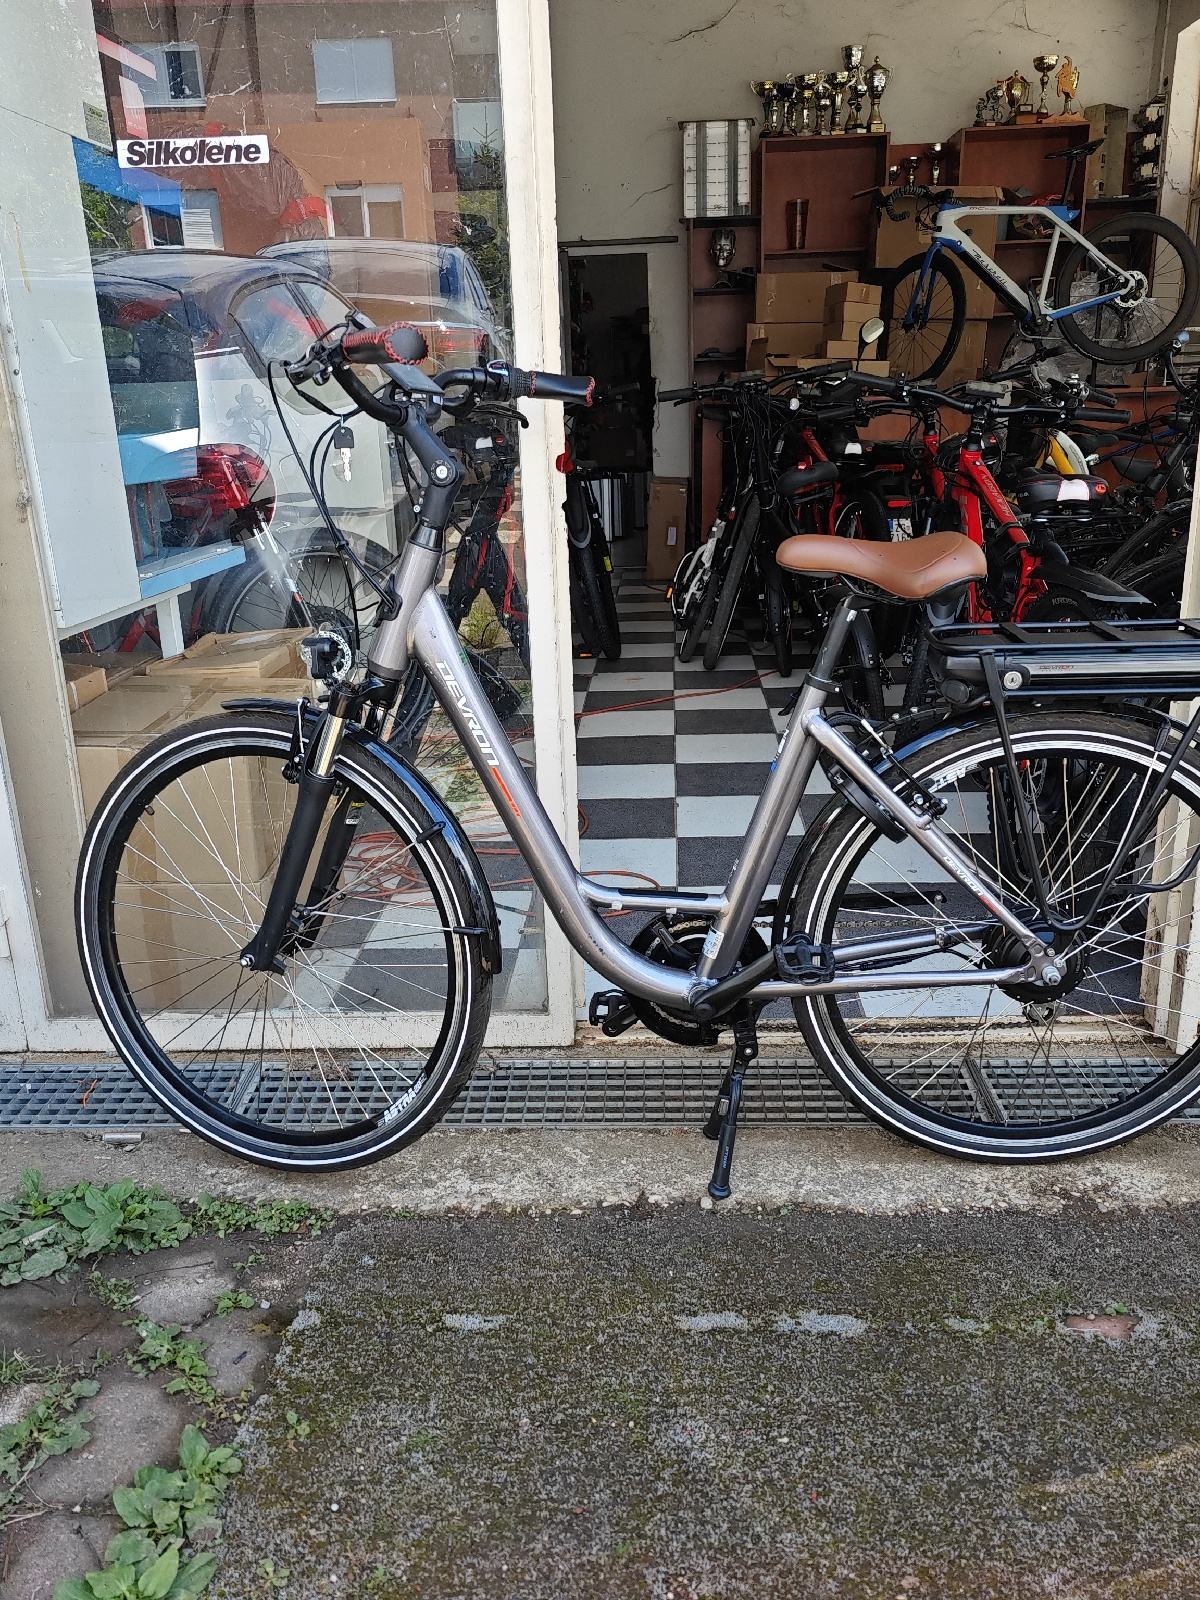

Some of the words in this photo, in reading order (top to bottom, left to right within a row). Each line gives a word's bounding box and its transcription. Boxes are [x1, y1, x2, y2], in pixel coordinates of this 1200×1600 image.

[127, 139, 261, 166] Silkolene
[436, 660, 500, 766] DEVRON
[943, 856, 984, 896] DEVRON
